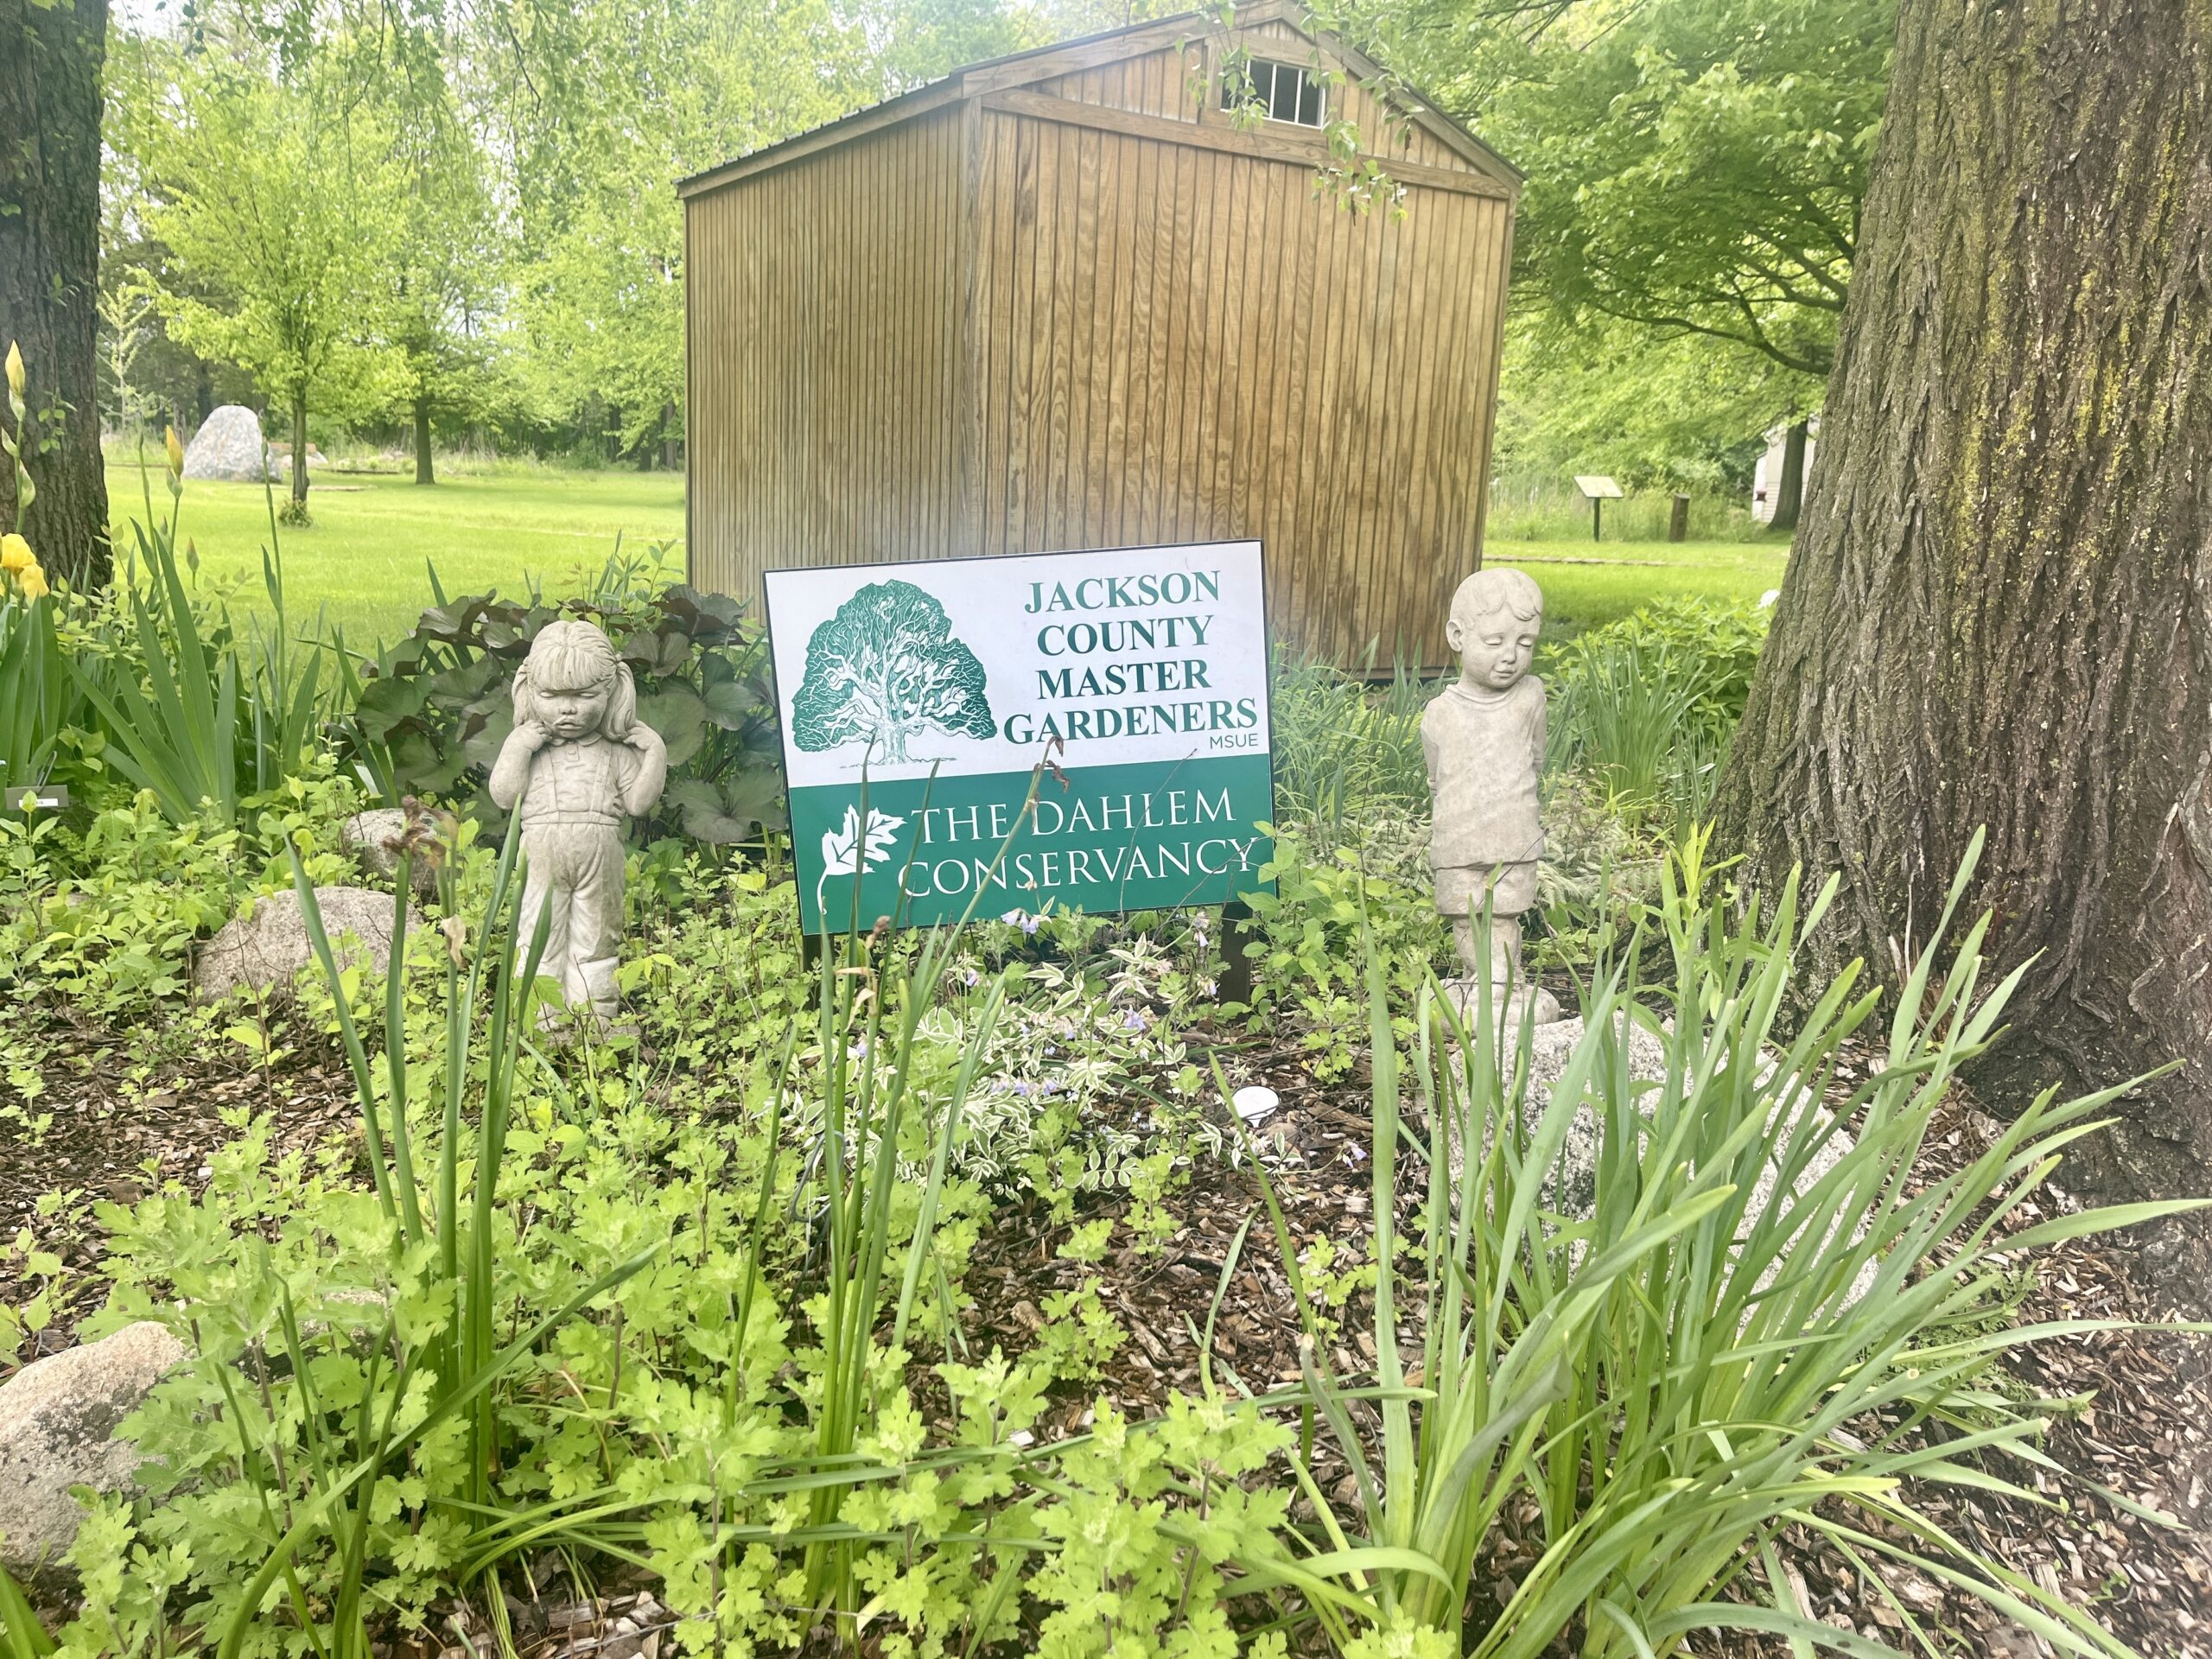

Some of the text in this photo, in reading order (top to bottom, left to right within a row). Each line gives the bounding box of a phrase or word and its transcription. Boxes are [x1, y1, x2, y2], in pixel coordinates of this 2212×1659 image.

[1024, 570, 1221, 613] JACKSON
[1037, 615, 1214, 656] COUNTY
[1035, 659, 1211, 700] MASTER
[1004, 697, 1258, 745] GARDENERS
[1210, 734, 1259, 749] MSUE
[910, 786, 1237, 844] THE DAHLEM
[898, 836, 1259, 897] CONSERVANCY
